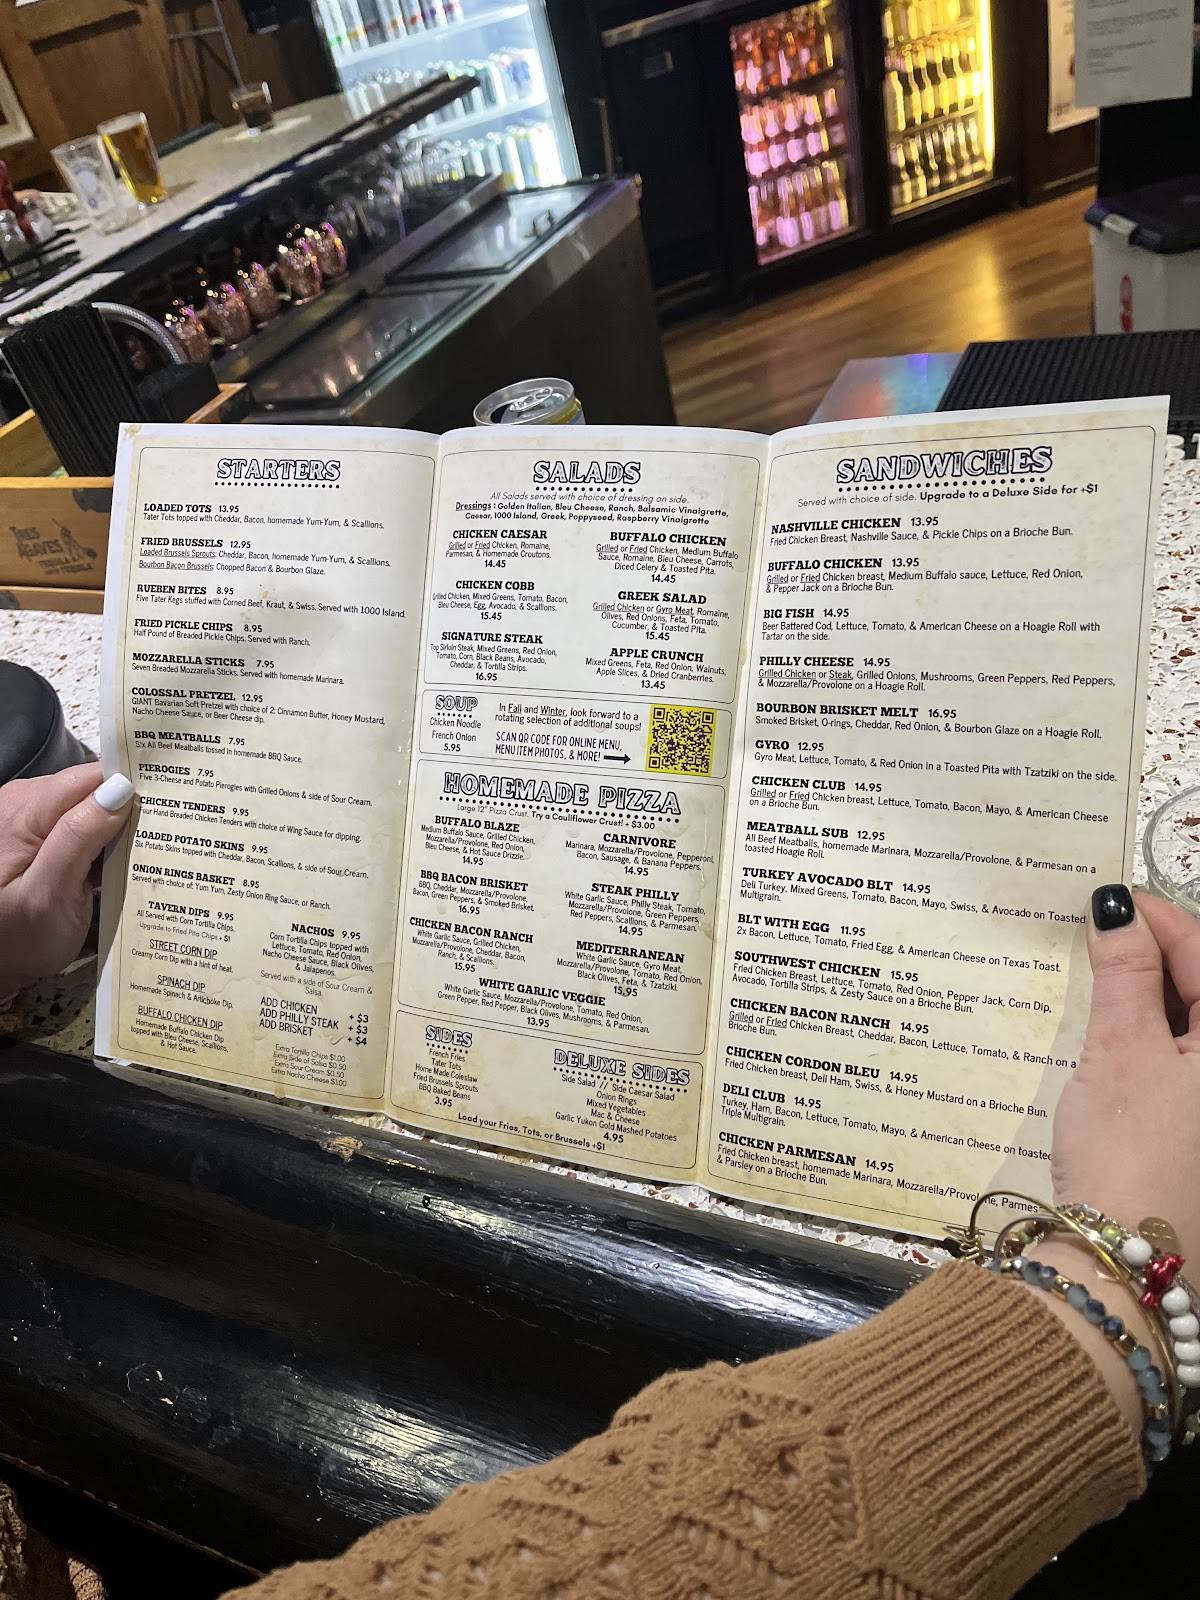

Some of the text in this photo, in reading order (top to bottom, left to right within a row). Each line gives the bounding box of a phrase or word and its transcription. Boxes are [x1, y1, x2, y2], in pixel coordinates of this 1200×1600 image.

[217, 458, 341, 481] STARTERS
[533, 461, 641, 484] SALADS
[837, 446, 1052, 484] SANDWICHES
[797, 483, 1098, 508] Served with choice of side. Upgrade to a Deluxe Side for +$1
[144, 504, 239, 513] LOADED TOTS 13.95
[143, 513, 160, 521] Tater
[161, 513, 175, 521] Tots
[176, 514, 198, 523] topped
[214, 515, 242, 524] Cheddar,
[244, 516, 265, 524] Bacon,
[267, 516, 304, 525] homemade
[306, 518, 341, 528] Yum-Yum,
[343, 519, 349, 527] &
[351, 519, 384, 529] Scallions.
[771, 516, 939, 535] NASHVILLE CHICKEN 13.95
[453, 530, 548, 539] CHICKEN CAESAR
[610, 532, 727, 547] BUFFALO CHICKEN
[141, 538, 251, 549] FRIED BRUSSELS 12.95
[484, 560, 506, 568] 14.45
[768, 558, 920, 572] BUFFALO CHICKEN 13.95
[456, 581, 535, 591] CHICKEN COBB
[651, 574, 676, 584] 14.45
[137, 585, 234, 595] RUEBEN BITES 8.95
[618, 591, 707, 605] GREEK SALAD
[481, 612, 502, 621] 15.45
[134, 619, 263, 633] FRIED PICKLE CHIPS 8.95
[645, 632, 670, 641] 15.45
[762, 632, 784, 641] Tartar
[797, 632, 810, 641] the
[812, 632, 830, 641] side.
[132, 654, 275, 669] MOZZARELLA STICKS 7.95
[609, 648, 704, 663] APPLE CRUNCH
[759, 656, 891, 667] PHILLY CHEESE 14.95
[641, 680, 666, 690] 13.45
[132, 688, 263, 703] COLOSSAL PRETZEL 12.95
[435, 695, 478, 711] SOUP
[756, 704, 957, 719] BOURBON BRISKET MELT 16.95
[432, 731, 477, 742] French Onion
[496, 732, 623, 752] SCAN QR CODE FOR ONLINE MENU,
[444, 743, 461, 752] 5.95
[755, 740, 824, 752] GYRO 12.95
[138, 765, 214, 778] PIEROGIES 7.95
[444, 771, 681, 815] HOMEMADE PIZZA
[435, 816, 520, 833] BUFFALO BLAZE
[603, 833, 677, 849] CARNIVORE
[462, 857, 484, 866] 14.95
[133, 865, 260, 889] ONION RINGS BASKET 8.95
[624, 866, 649, 877] 14.95
[742, 868, 931, 894] TURKEY AVOCADO BLT 14.95
[591, 883, 680, 901] STEAK PHILLY
[148, 902, 234, 921] TAVERN DIPS 9.95
[291, 924, 361, 940] NACHOS 9.95
[410, 918, 534, 943] CHICKEN BACON RANCH
[617, 926, 643, 937] 14.95
[576, 941, 685, 964] MEDITERRANEAN
[454, 962, 477, 973] 15.95
[734, 951, 919, 982] SOUTHWEST CHICKEN 15.95
[478, 977, 606, 1007] WHITE GARLIC VEGGIE
[614, 986, 638, 997] 15.95
[260, 997, 279, 1008] ADD
[280, 1000, 318, 1015] CHICKEN
[357, 1013, 369, 1024] $3
[527, 1017, 550, 1028] 13.95
[425, 1025, 472, 1048] SIDES
[428, 1048, 466, 1062] French Fries
[431, 1059, 462, 1071] Tater Tots
[554, 1048, 690, 1086] DELUXE SIDES
[726, 1046, 918, 1083] CHICKEN CORDON BLEU 14.95
[434, 1097, 453, 1108] 3.95
[596, 1091, 637, 1107] Onion Rings
[603, 1132, 624, 1144] 4.95
[719, 1132, 894, 1172] CHICKEN PARMESAN 14.95
